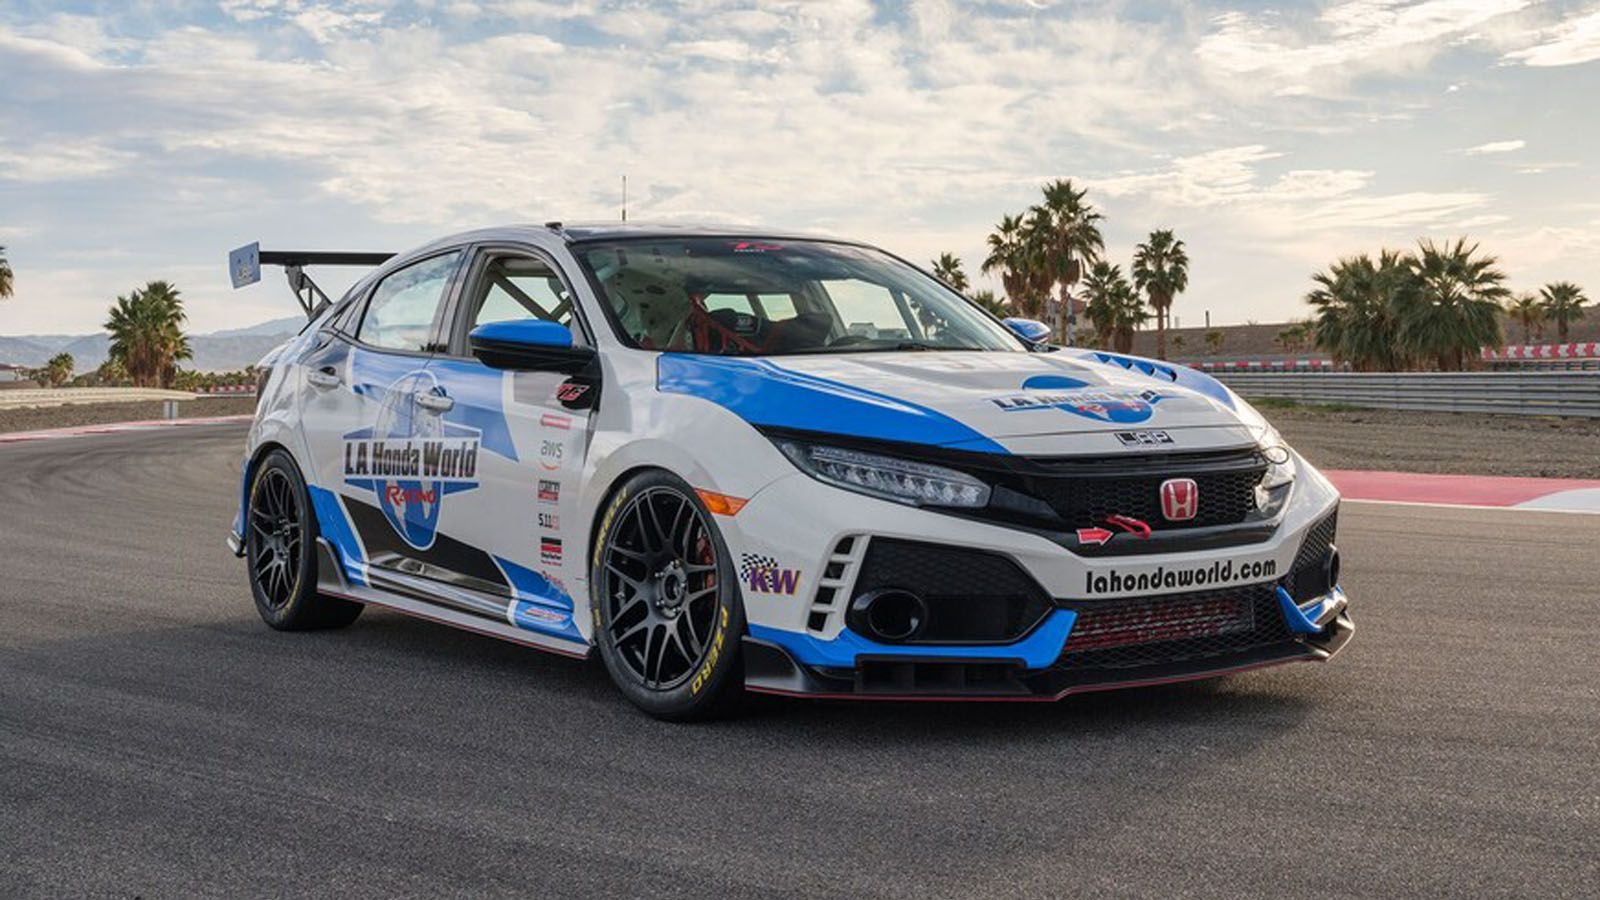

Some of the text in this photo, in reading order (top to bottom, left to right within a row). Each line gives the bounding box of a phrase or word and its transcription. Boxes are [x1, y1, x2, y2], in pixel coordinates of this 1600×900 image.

[372, 441, 420, 476] Honda
[423, 441, 478, 477] World
[541, 440, 563, 459] aws
[750, 567, 801, 595] KW
[1085, 559, 1276, 594] lahondaworld.com
